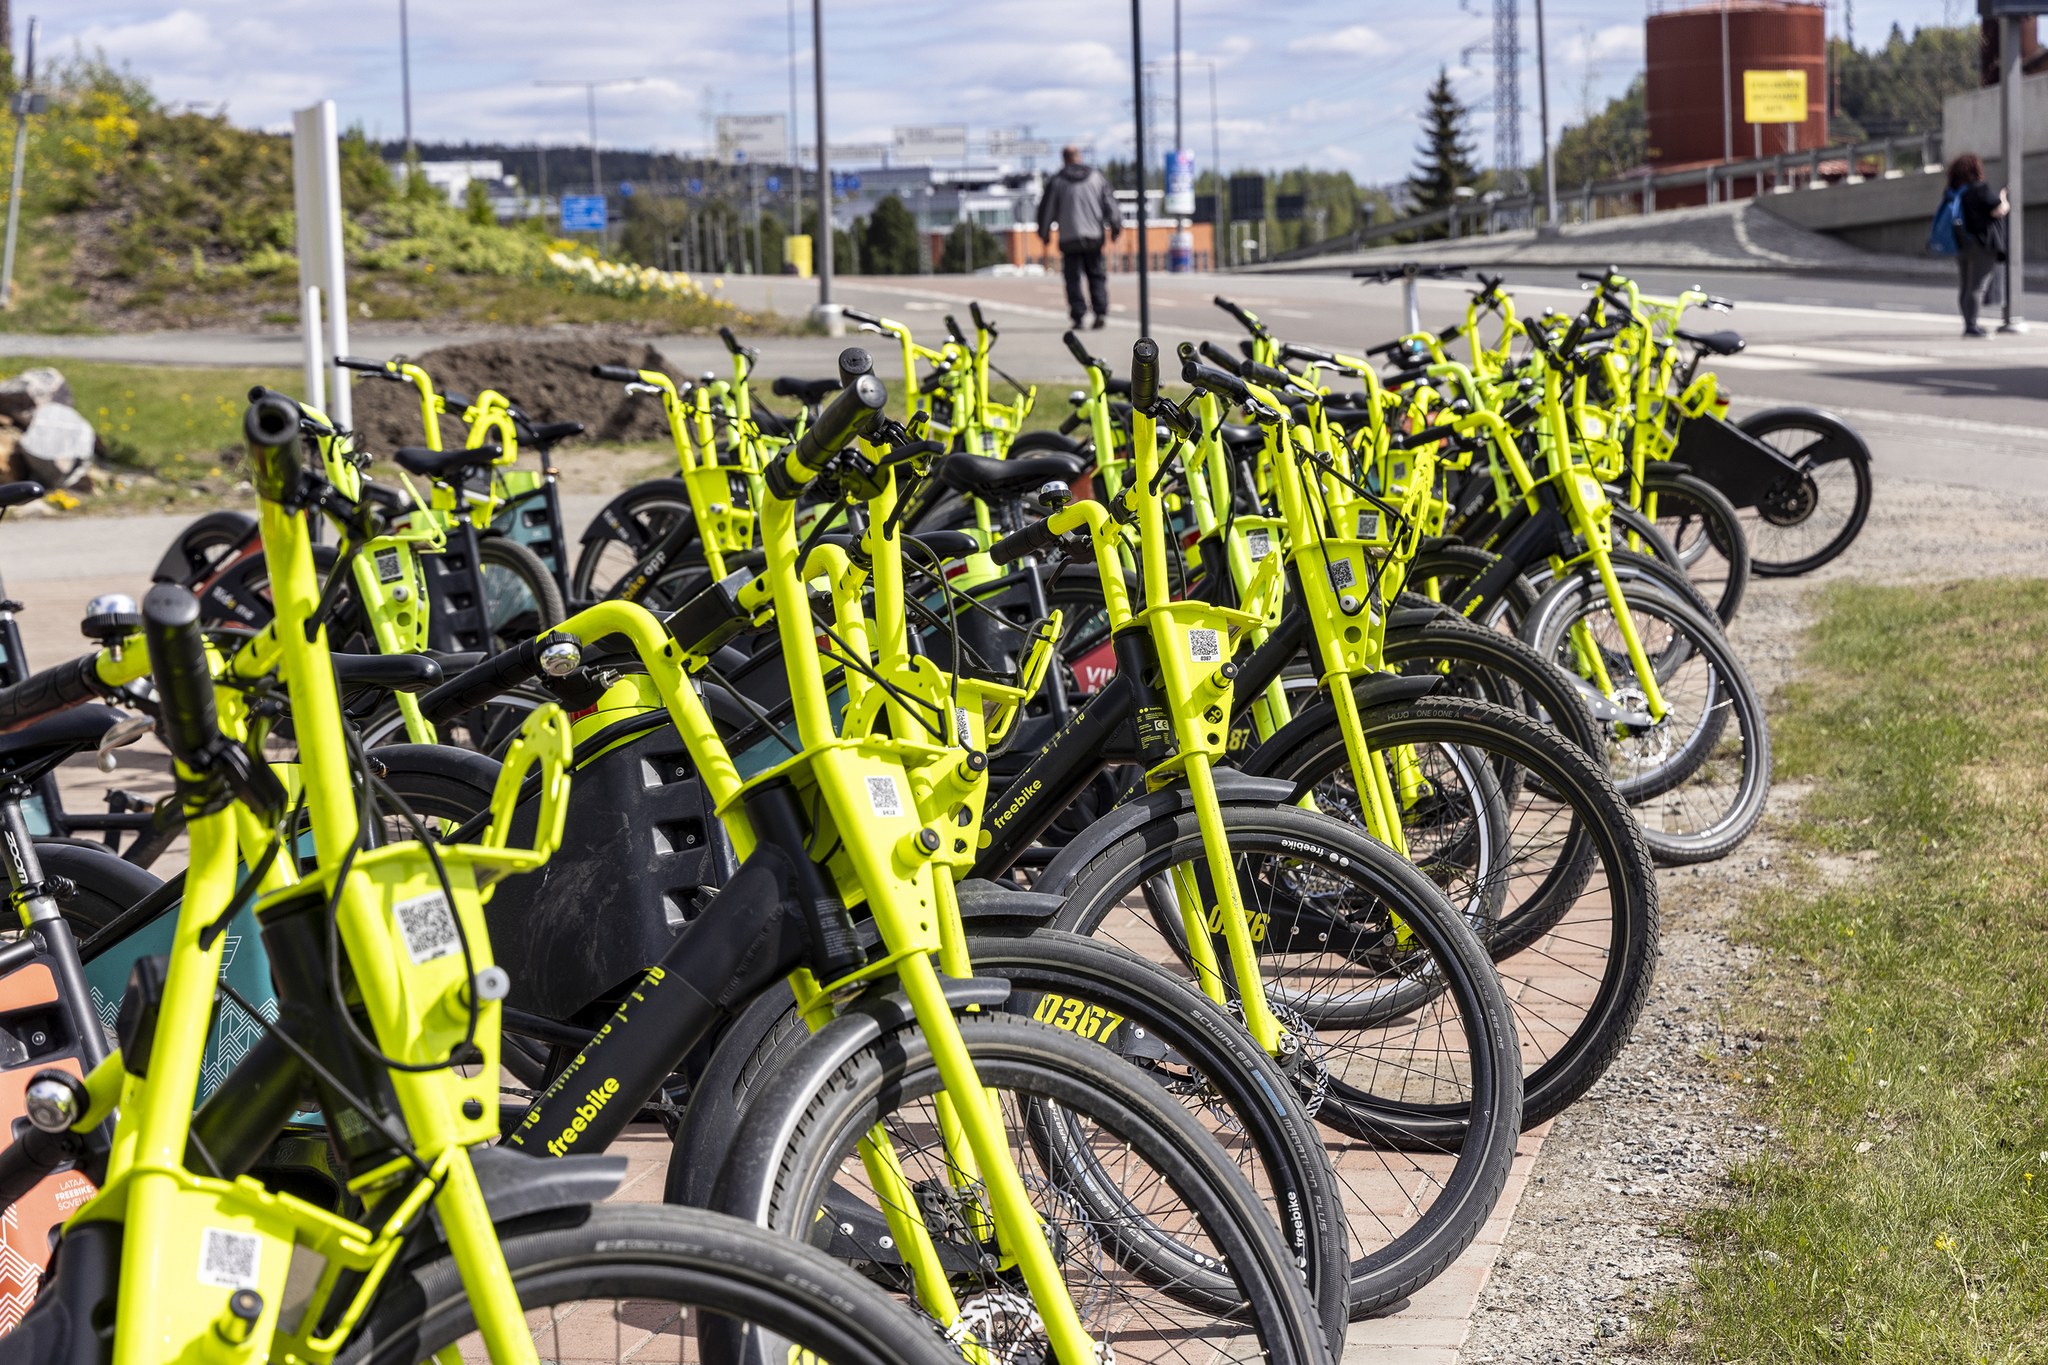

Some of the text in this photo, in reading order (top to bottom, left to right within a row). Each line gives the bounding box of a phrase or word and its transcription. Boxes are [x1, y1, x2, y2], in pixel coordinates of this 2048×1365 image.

[993, 779, 1043, 830] freebike
[1280, 839, 1325, 858] freebike
[1032, 992, 1125, 1044] 0367
[546, 1077, 620, 1159] freebike
[1189, 1009, 1254, 1070] SCHWALBE
[1313, 1194, 1328, 1232] PLUS
[59, 1177, 86, 1191] LATAA
[1287, 1191, 1306, 1249] freebike
